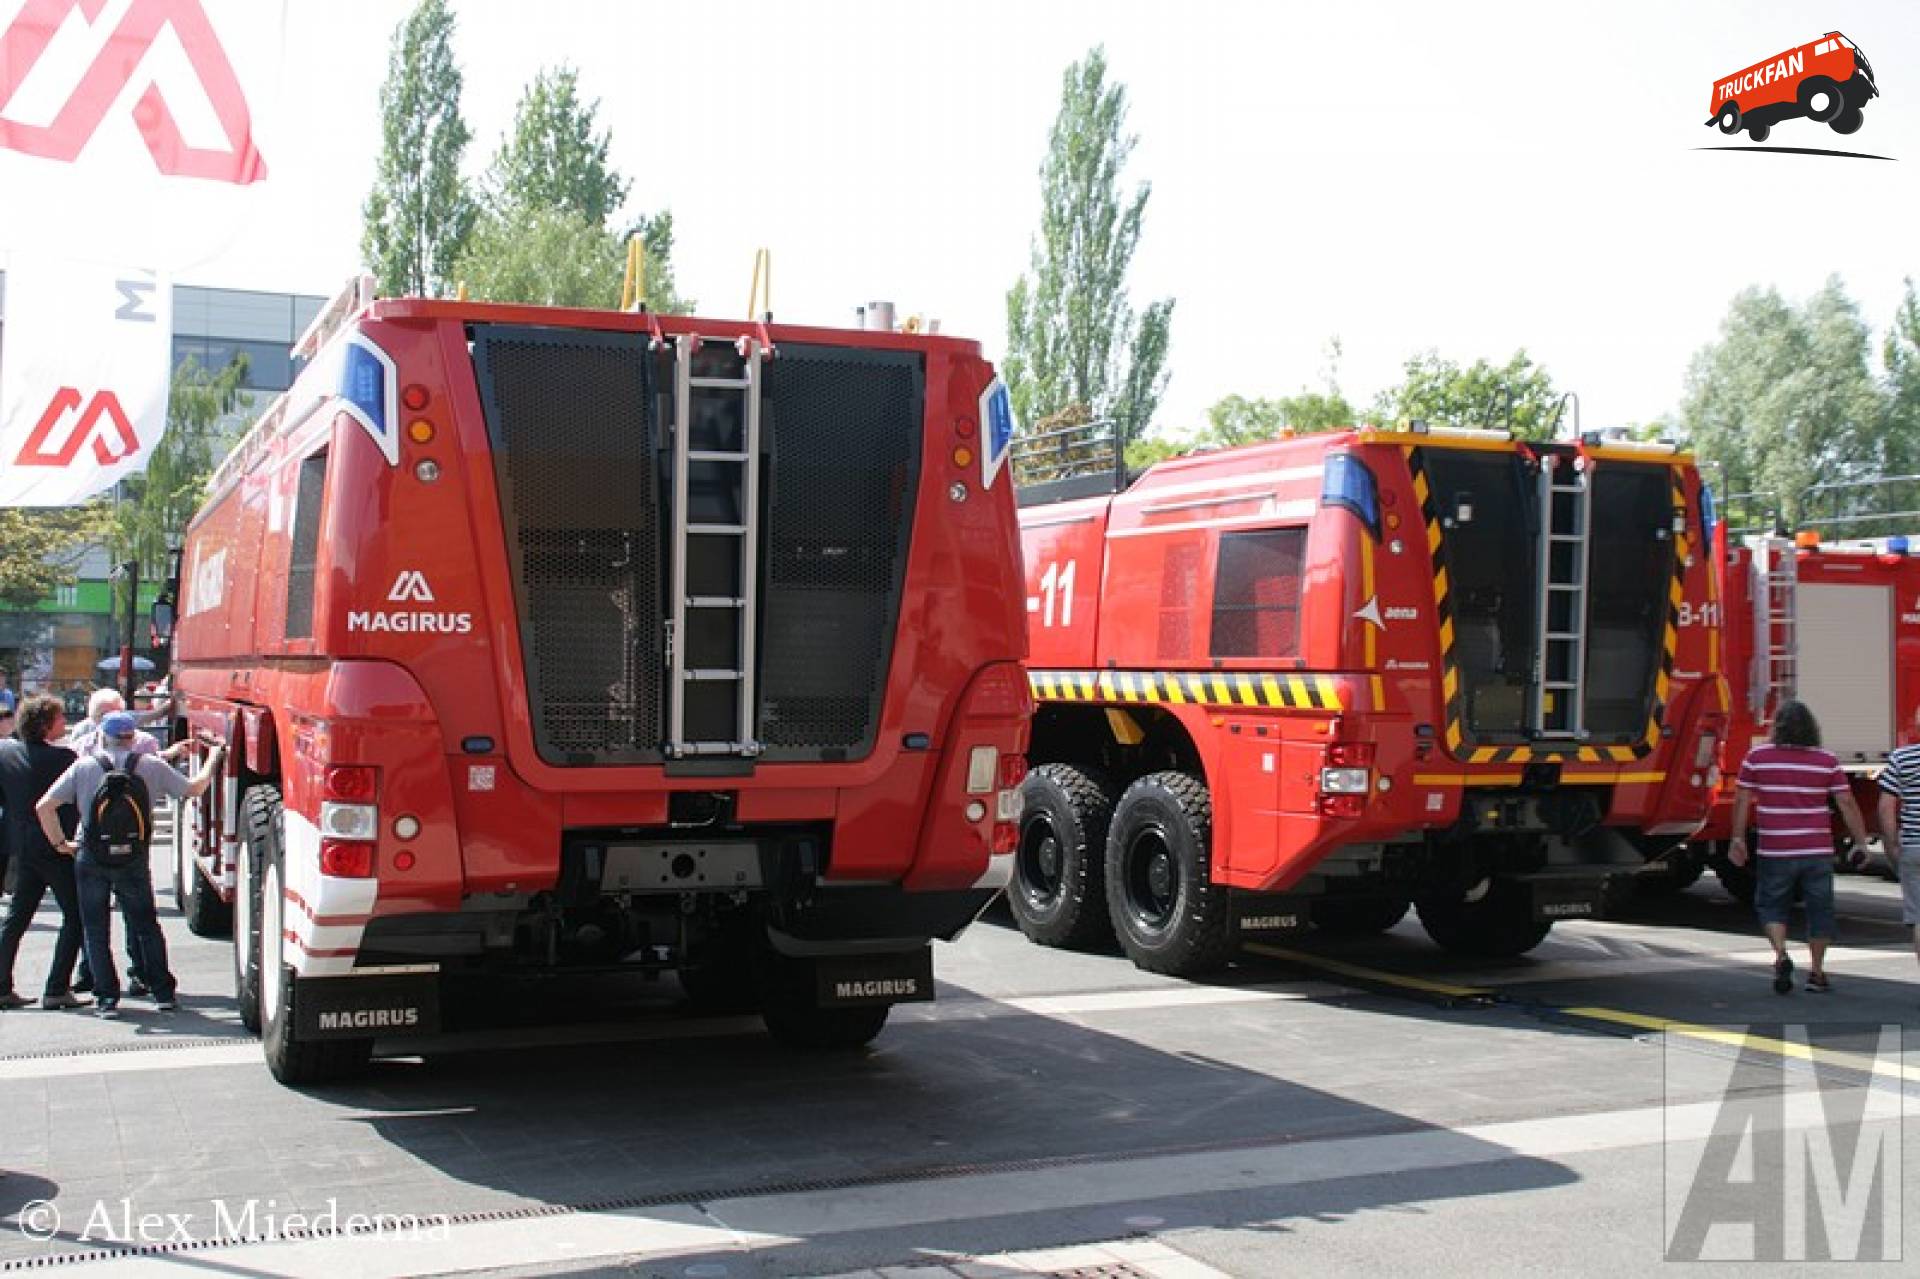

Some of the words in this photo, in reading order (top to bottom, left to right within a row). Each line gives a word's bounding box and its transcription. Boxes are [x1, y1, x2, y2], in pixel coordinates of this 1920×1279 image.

[347, 611, 472, 632] MAGIRUS
[1240, 915, 1297, 929] MAGIRUS
[835, 979, 916, 997] MAGIRUS
[318, 1007, 419, 1030] MAGIRUS
